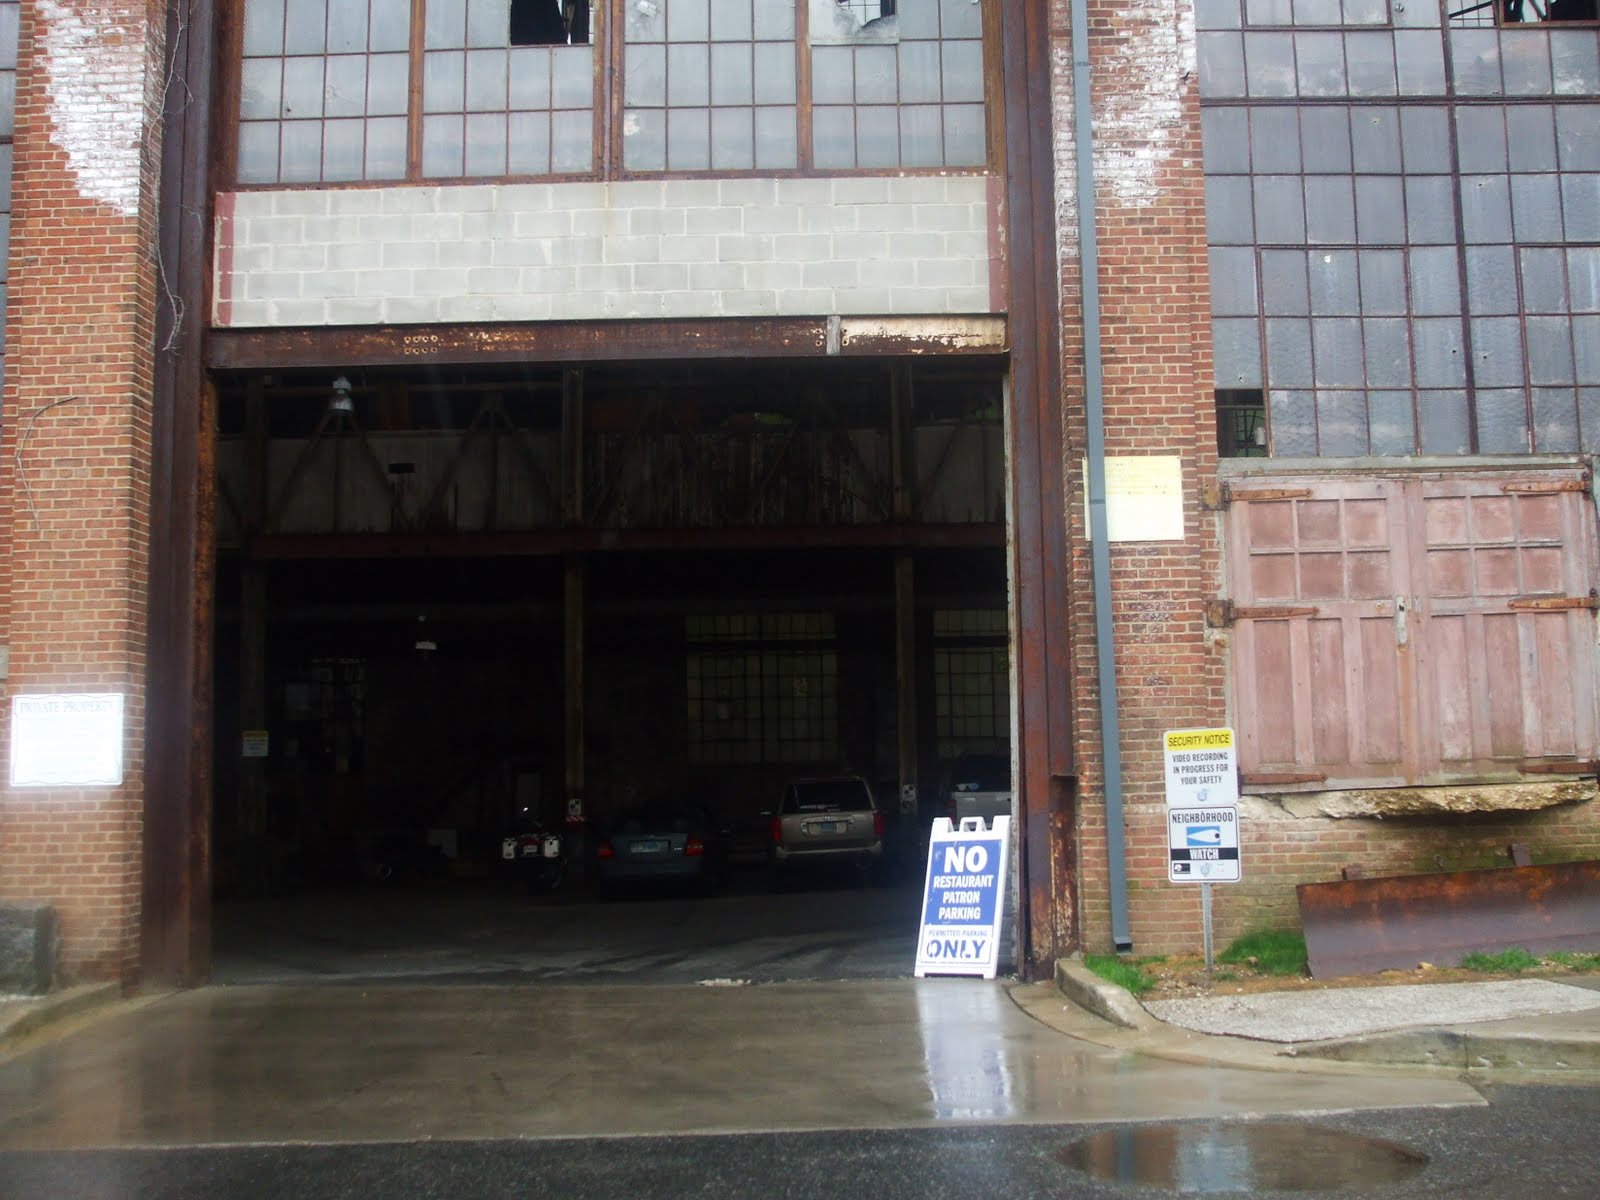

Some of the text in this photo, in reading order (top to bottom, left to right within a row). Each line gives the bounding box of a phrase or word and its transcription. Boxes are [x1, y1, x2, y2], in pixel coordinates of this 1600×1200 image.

[1168, 733, 1230, 747] SECURITY NOTICE
[1172, 752, 1228, 763] VIDEO RECORDING
[1173, 763, 1229, 774] IN PROGRESS FOR
[1180, 775, 1223, 785] YOUR SAFETY
[1172, 811, 1234, 824] NEIGHBORHOOD
[944, 846, 988, 873] NO
[1190, 848, 1219, 860] WATCH
[933, 875, 994, 889] RESTAURANT
[942, 891, 980, 904] PATRON
[938, 907, 981, 920] PARKING
[962, 929, 988, 937] PARKING
[926, 939, 986, 959] ONLY
